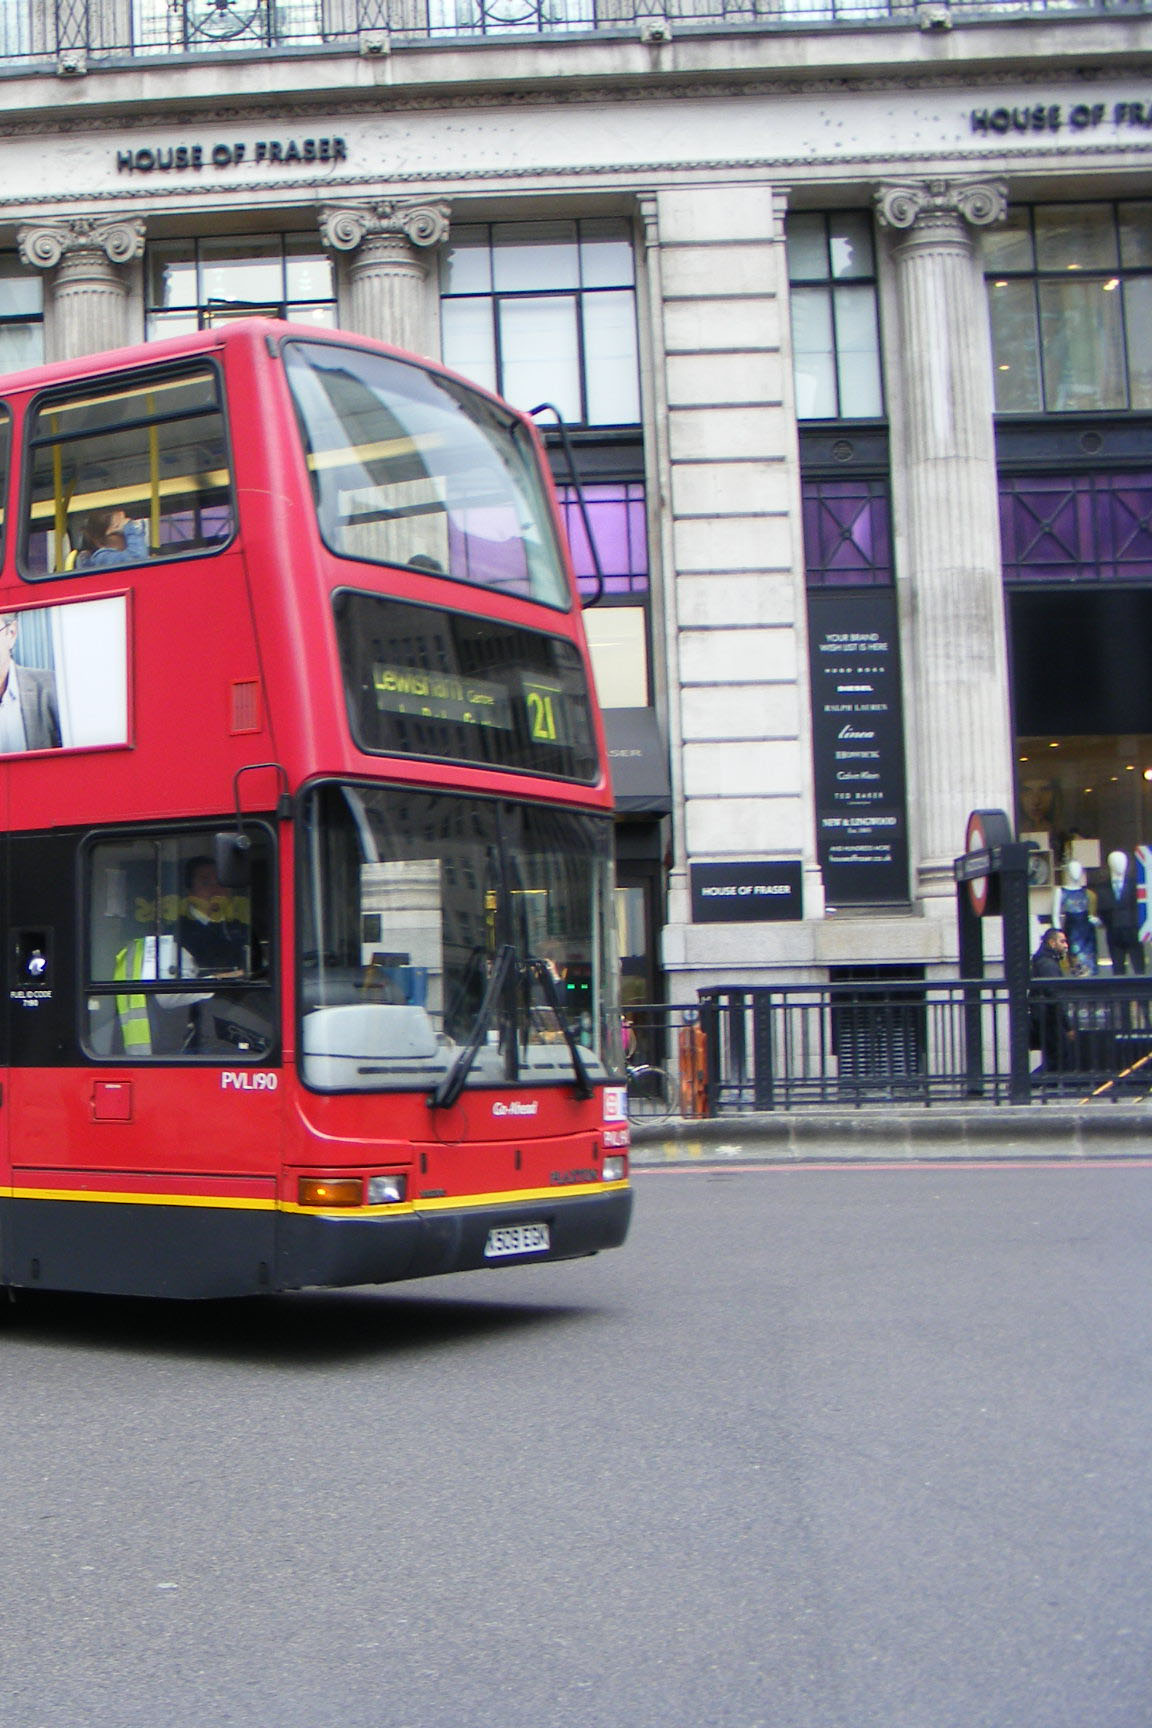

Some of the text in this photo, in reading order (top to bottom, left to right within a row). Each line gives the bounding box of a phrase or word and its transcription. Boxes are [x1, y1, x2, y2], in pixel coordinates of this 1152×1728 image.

[970, 104, 1062, 136] HOUSE
[1070, 104, 1105, 129] OF
[117, 138, 346, 174] HOUSE OF FRASER
[825, 633, 879, 642] YOUR BRAND
[819, 644, 842, 652] WISH
[868, 643, 889, 651] HERE
[526, 692, 556, 740] 21
[838, 724, 876, 739] linea
[701, 885, 791, 896] HOUSE OF FRASER
[221, 1071, 278, 1090] PVL190
[492, 1100, 538, 1116] Go-Ahead
